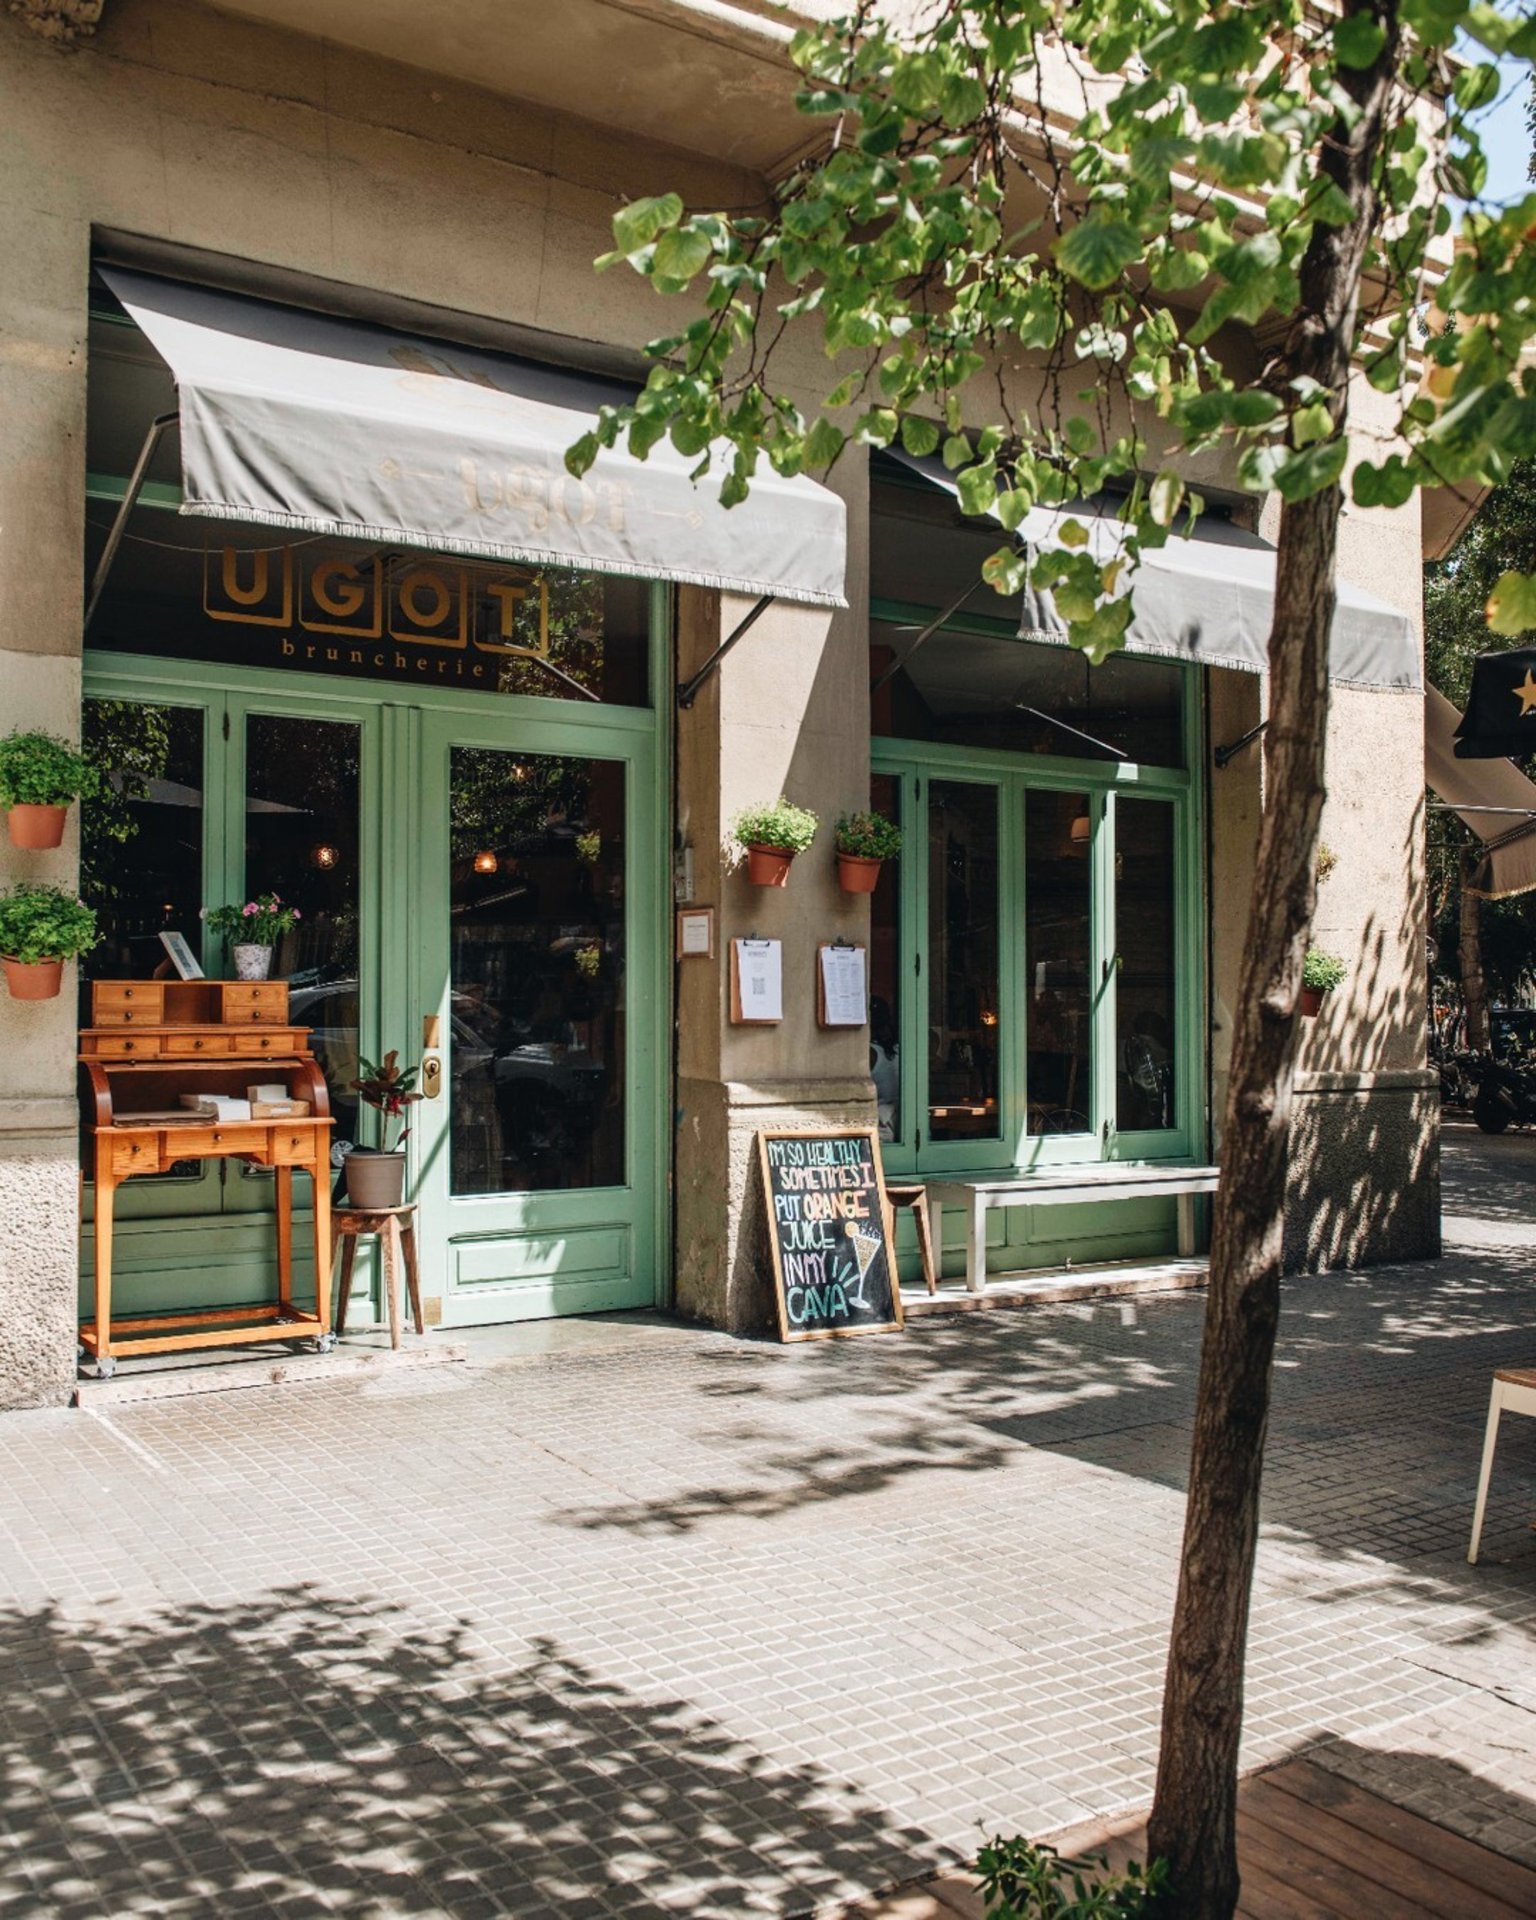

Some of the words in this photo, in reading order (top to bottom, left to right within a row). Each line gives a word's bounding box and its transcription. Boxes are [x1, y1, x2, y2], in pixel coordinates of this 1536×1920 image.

[222, 544, 528, 637] UGOT
[282, 638, 484, 677] bruncherie
[788, 1141, 803, 1166] SO
[806, 1140, 861, 1166] HEALTHY
[780, 1166, 860, 1190] SOMETIMES
[861, 1162, 875, 1188] I
[775, 1194, 800, 1220] PUT
[803, 1190, 869, 1220] ORANGE
[782, 1220, 835, 1250] JUICE
[784, 1254, 803, 1287] IN
[803, 1252, 826, 1284] MY
[787, 1283, 849, 1323] CAVA
